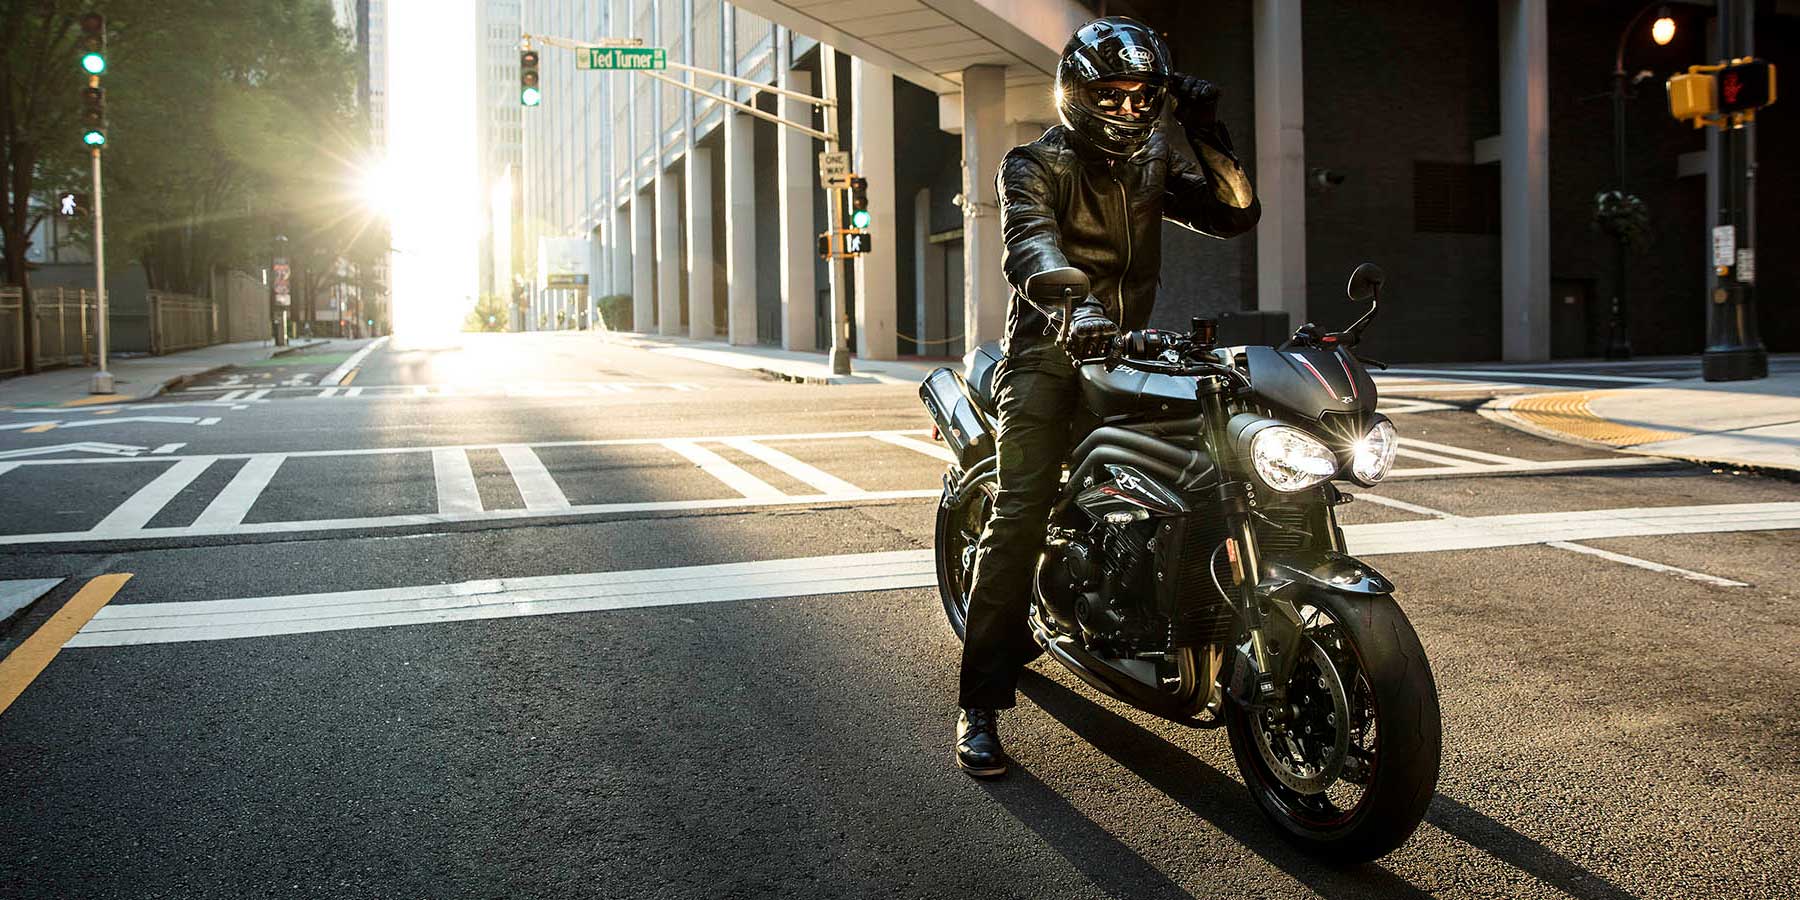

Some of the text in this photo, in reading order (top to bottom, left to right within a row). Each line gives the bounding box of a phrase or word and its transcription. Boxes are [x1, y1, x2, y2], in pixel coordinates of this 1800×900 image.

[591, 50, 613, 67] Ted
[615, 50, 652, 68] Turner
[825, 155, 844, 164] ONE
